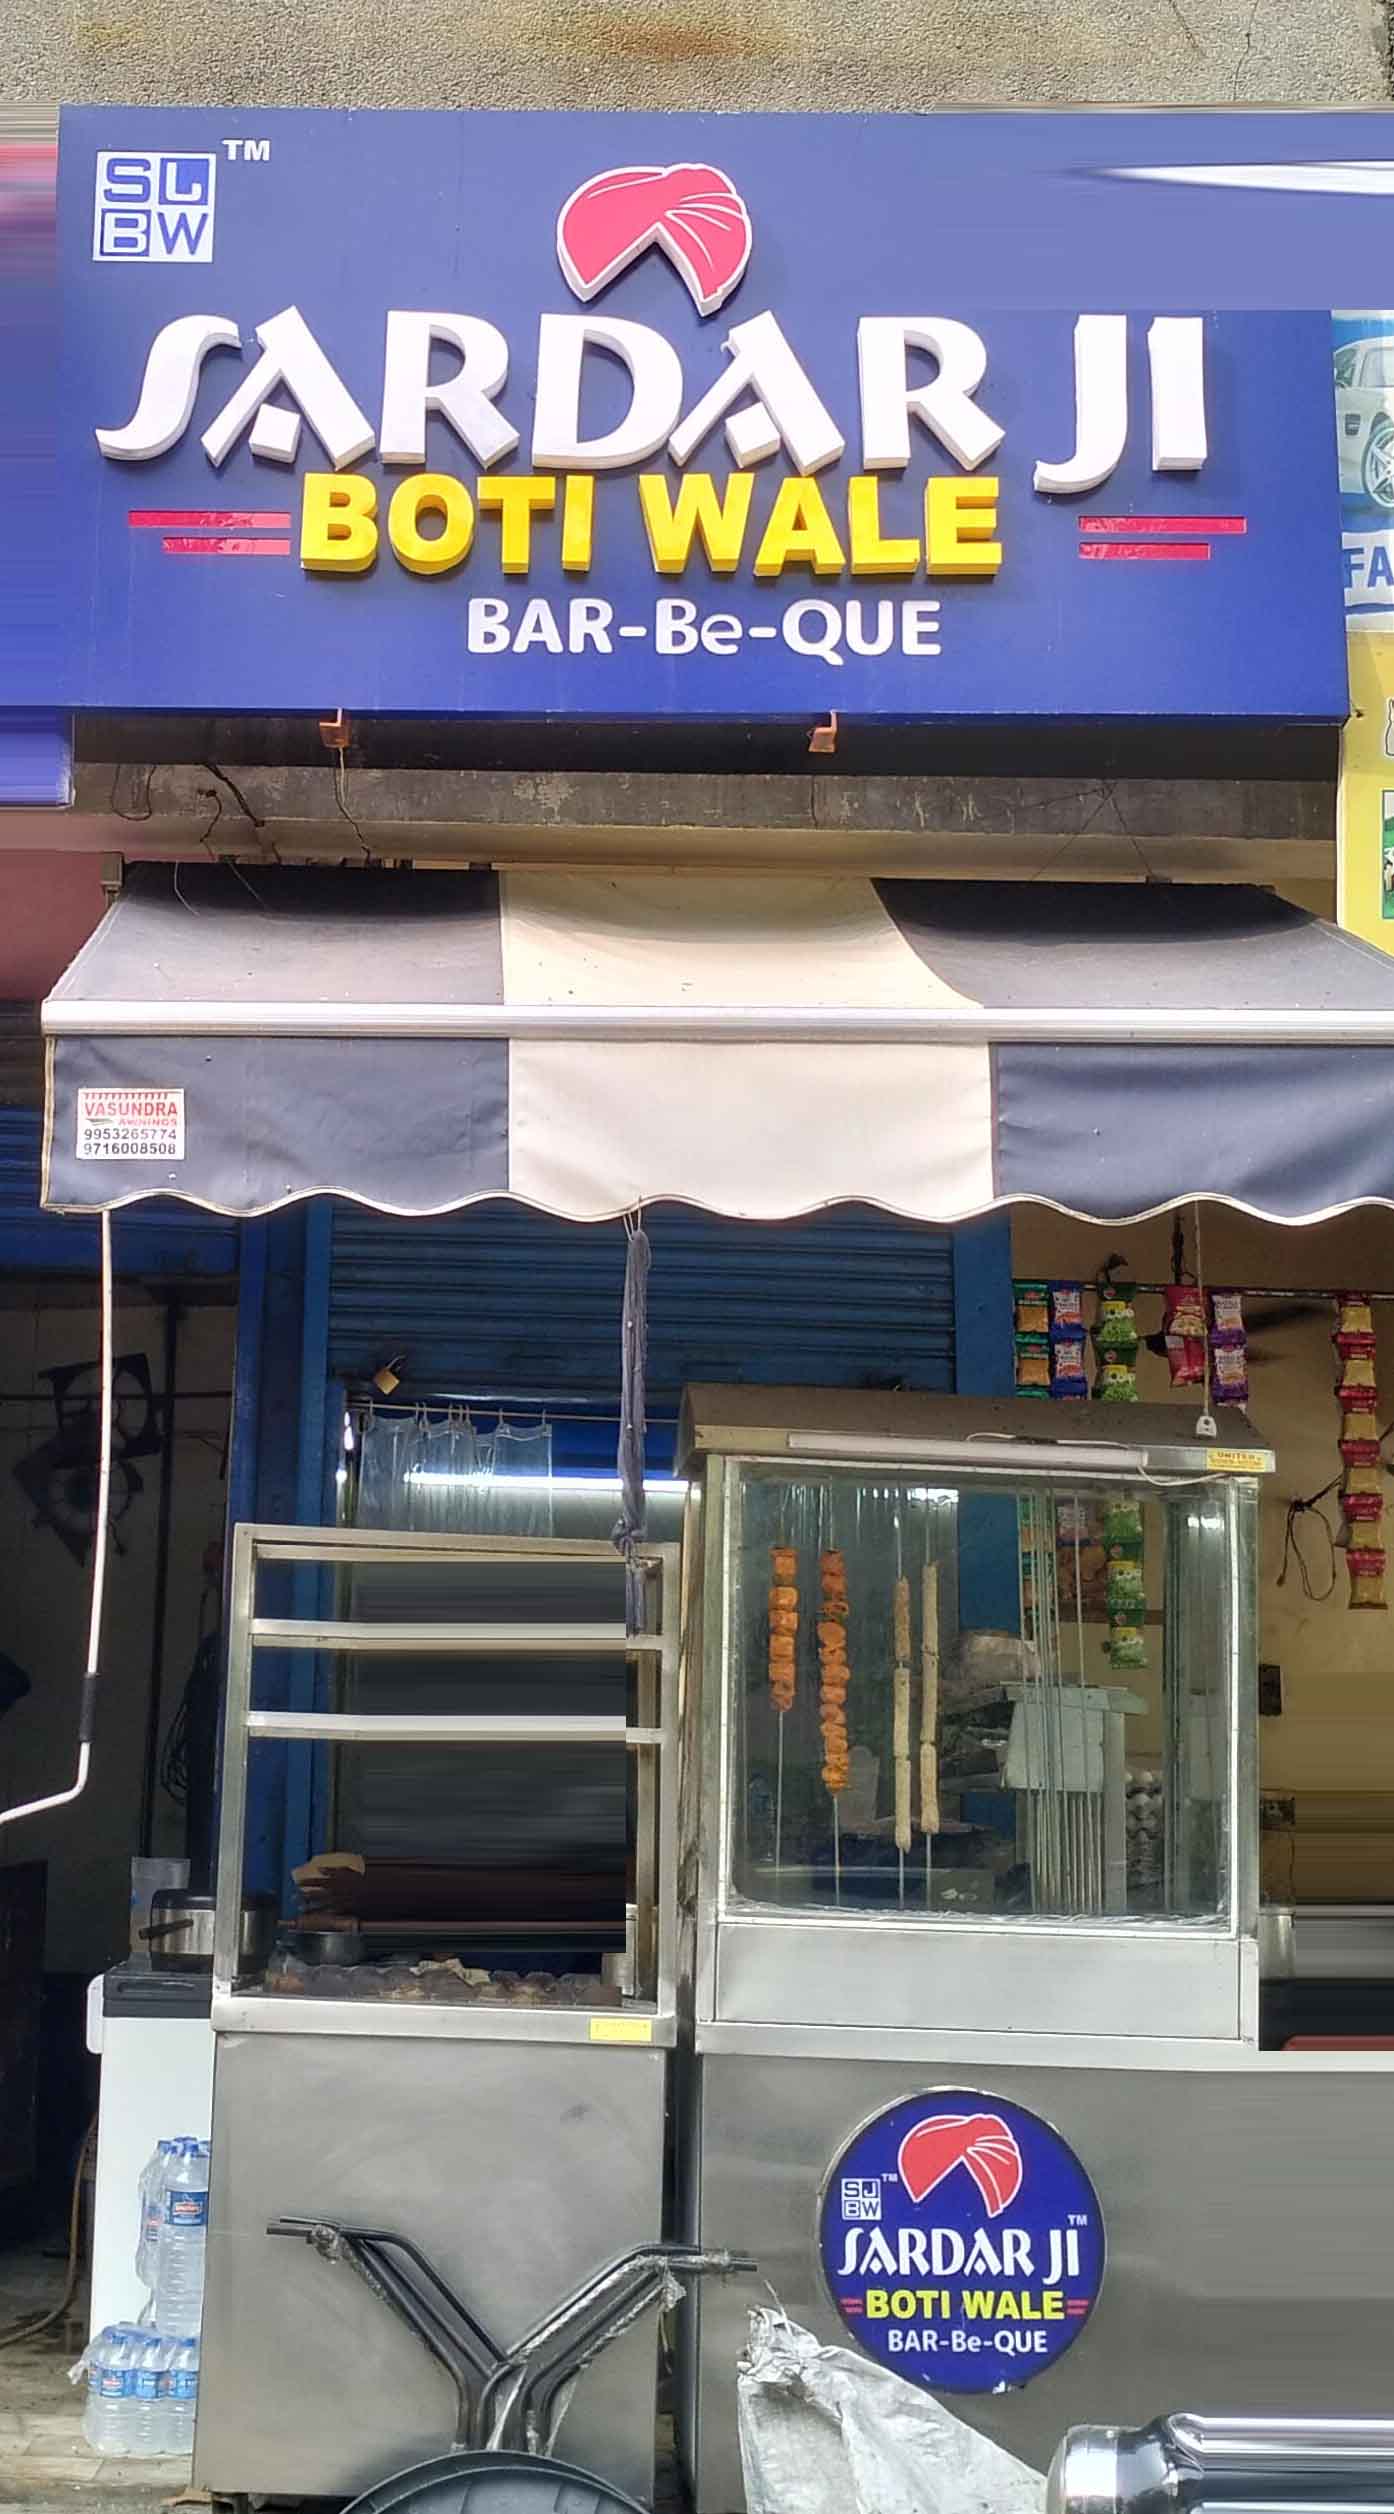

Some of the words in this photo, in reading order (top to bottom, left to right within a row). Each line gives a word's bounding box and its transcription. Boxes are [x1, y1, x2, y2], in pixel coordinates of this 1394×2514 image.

[223, 139, 270, 161] TM
[95, 304, 1006, 477] SARDAR
[1033, 313, 1208, 494] JI
[300, 472, 594, 575] BOTI
[638, 472, 1003, 577] WALE
[466, 597, 943, 666] BAR-Be-QUE
[84, 1102, 178, 1117] VASUNDRA
[83, 1127, 177, 1140] 9953265774
[83, 1142, 177, 1155] 9716008508
[844, 2181, 878, 2198] SJ
[844, 2201, 879, 2217] BW
[1067, 2215, 1088, 2226] TM
[838, 2226, 1035, 2277] SARDAR
[1042, 2229, 1081, 2285] JI
[866, 2290, 951, 2319] BOTI
[963, 2290, 1066, 2320] WALE
[887, 2329, 1048, 2356] BAR-Be-QUE
